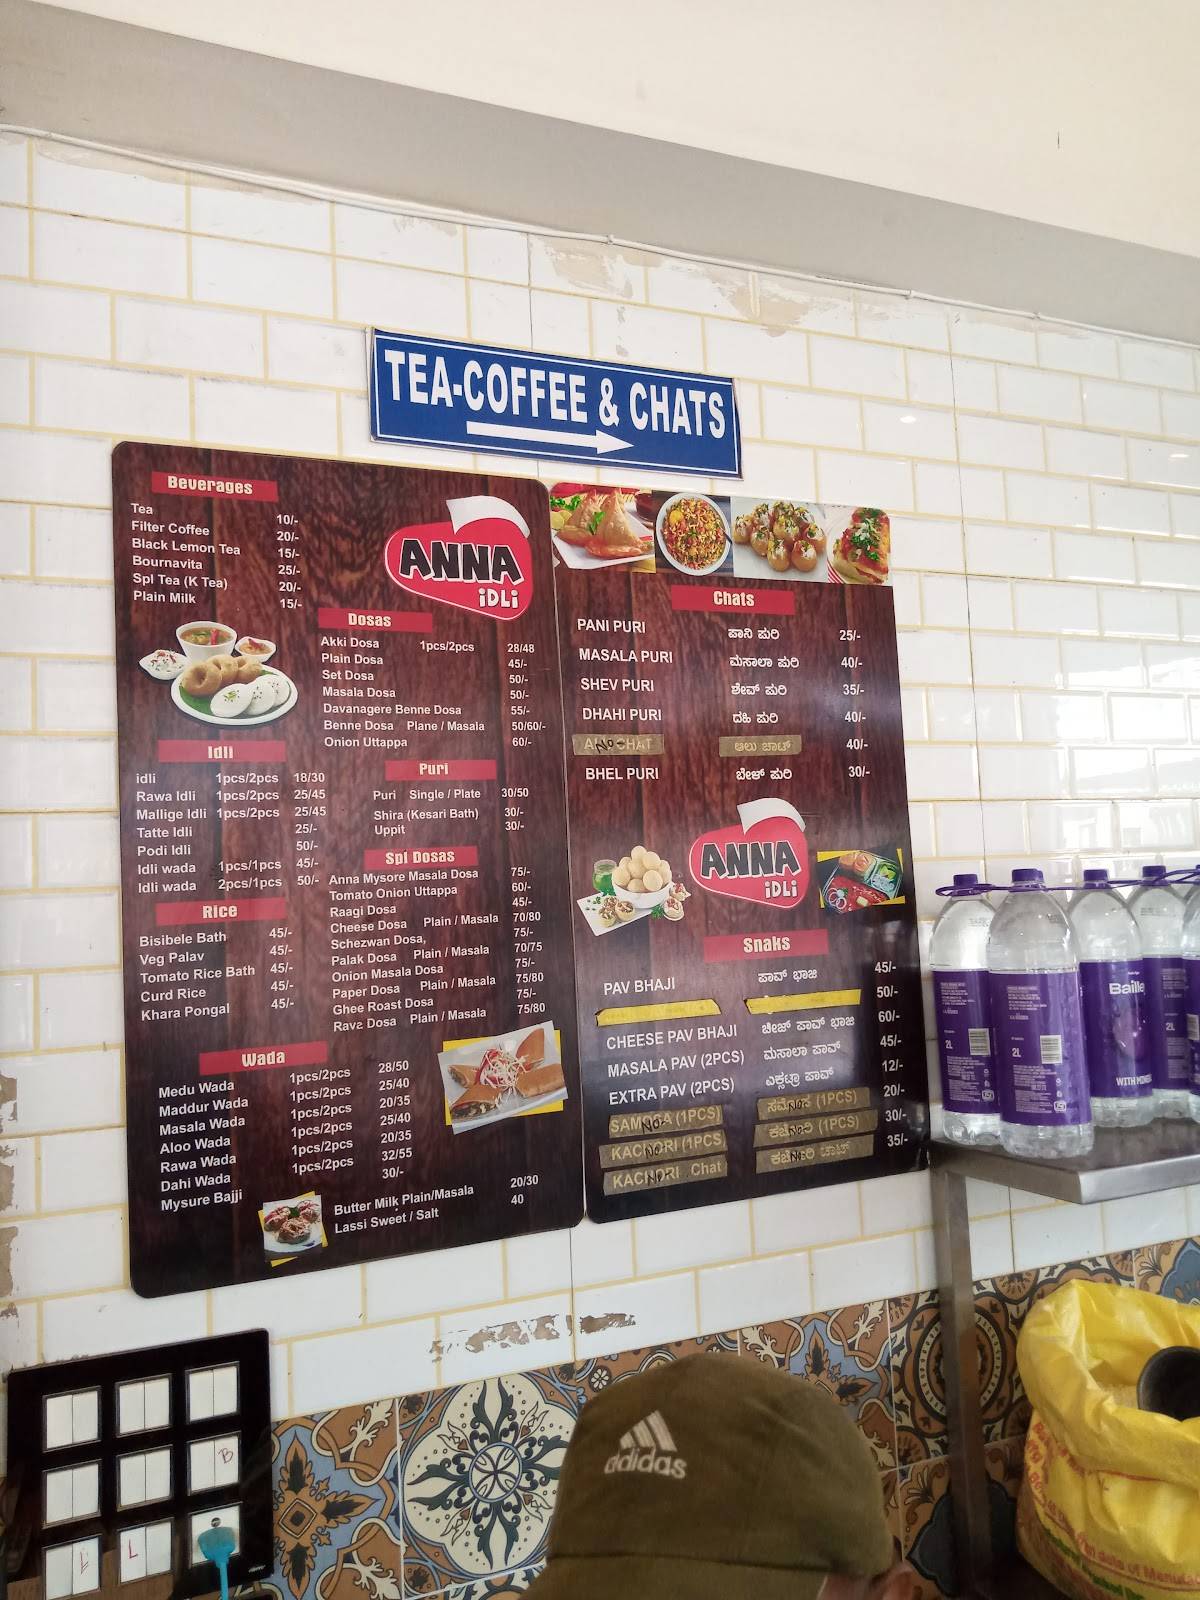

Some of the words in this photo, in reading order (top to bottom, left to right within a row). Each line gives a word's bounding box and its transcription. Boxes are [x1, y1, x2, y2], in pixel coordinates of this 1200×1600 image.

[384, 349, 588, 423] TEA-COFFEE
[599, 378, 620, 426] &
[629, 382, 726, 438] CHATS
[168, 476, 252, 494] Beverages
[131, 503, 152, 514] Tea
[277, 514, 298, 524] 10/-
[132, 521, 165, 532] Filter
[169, 523, 209, 535] Coffee
[277, 531, 299, 541] 20/-
[133, 538, 167, 549] Black
[172, 541, 215, 553] Lemon
[219, 544, 240, 554] Tea
[278, 548, 299, 558] 15/-
[133, 556, 202, 569] Bournavita
[279, 565, 300, 575] 25/-
[399, 538, 524, 586] ANNA
[133, 573, 153, 586] Spl
[158, 575, 180, 585] Tea
[184, 576, 198, 588] (K
[202, 577, 227, 590] Tea)
[279, 582, 301, 592] 20/-
[134, 590, 165, 601] Plain
[170, 593, 195, 603] Milk
[280, 599, 302, 608] 15/-
[714, 591, 754, 606] Chats
[349, 613, 391, 626] Dosas
[578, 619, 609, 631] PANI
[614, 620, 645, 633] PURI
[840, 630, 860, 640] 25/-
[321, 637, 346, 646] Akki
[351, 638, 379, 648] Dosa
[420, 641, 474, 653] 1pcs/2pcs
[508, 644, 534, 653] 28/48
[322, 653, 350, 663] Plain
[355, 654, 383, 664] Dosa
[508, 659, 527, 668] 45/-
[579, 648, 638, 662] MASALA
[641, 651, 672, 663] PURI
[841, 657, 862, 668] 40/-
[323, 687, 363, 696] Masala
[367, 688, 395, 697] Dosa
[511, 690, 529, 699] 50/-
[581, 678, 618, 690] SHEV
[622, 679, 654, 691] PURI
[843, 684, 864, 695] 35/-
[324, 704, 391, 716] Davanagere
[396, 705, 430, 714] Benne
[434, 705, 461, 714] Dosa
[511, 706, 529, 715] 55/-
[583, 708, 625, 720] DHAHI
[630, 709, 661, 720] PURI
[845, 711, 866, 722] 40/-
[325, 737, 359, 746] Onion
[364, 737, 407, 749] Uttappa
[513, 737, 531, 746] 60/-
[208, 746, 233, 759] Idli
[420, 763, 448, 775] Puri
[586, 768, 623, 779] BHEL
[627, 768, 658, 779] PURI
[849, 766, 870, 777] 30/-
[137, 774, 155, 783] idli
[216, 773, 278, 785] 1pcs/2pcs
[294, 773, 324, 782] 18/30
[137, 792, 172, 801] Rawa
[177, 791, 195, 801] Idli
[217, 790, 279, 803] 1pcs/2pcs
[295, 789, 325, 799] 25/45
[373, 790, 395, 800] Puri
[410, 790, 444, 801] Single
[454, 789, 480, 798] Plate
[502, 788, 528, 797] 30/50
[137, 809, 183, 821] Mallige
[188, 809, 206, 818] Idli
[217, 808, 279, 820] 1pcs/2pcs
[295, 807, 326, 816] 25/45
[374, 811, 403, 820] Shira
[407, 810, 446, 821] (Kesari
[450, 808, 478, 819] Bath)
[505, 807, 523, 816] 30/-
[375, 825, 405, 836] Uppit
[506, 821, 524, 830] 30/-
[413, 851, 454, 863] Dosas
[699, 840, 802, 880] ANNA
[329, 875, 359, 885] Anna
[364, 874, 405, 885] Mysore
[409, 870, 447, 880] Masala
[451, 870, 478, 879] Dosa
[511, 867, 530, 876] 75/-
[329, 890, 372, 900] Tomato
[376, 888, 410, 898] Onion
[415, 887, 457, 897] Uttappa
[512, 882, 531, 891] 60/-
[203, 905, 237, 918] Rice
[140, 934, 192, 946] Bisibele
[197, 932, 226, 943] Bath
[269, 928, 292, 938] 45/-
[331, 938, 390, 949] Schezwan
[514, 927, 533, 937] 75/-
[744, 936, 790, 952] Snaks
[140, 971, 189, 983] Tomato
[194, 969, 222, 979] Rice
[226, 965, 255, 977] Bath
[271, 962, 293, 973] 45/-
[604, 981, 630, 995] PAV
[635, 977, 675, 992] BHAJI
[142, 1010, 180, 1021] Khara
[185, 1003, 229, 1017] Pongal
[271, 998, 294, 1008] 45/-
[333, 1005, 364, 1015] Ghee
[368, 1000, 401, 1011] Roast
[405, 999, 433, 1008] Dosa
[517, 988, 536, 998] 75/-
[1166, 1022, 1175, 1031] 2L
[607, 1032, 663, 1049] CHEESE
[668, 1029, 693, 1043] PAV
[698, 1025, 736, 1040] BHAJI
[242, 1051, 285, 1067] Wada
[1012, 1047, 1021, 1058] 2L
[159, 1085, 194, 1098] Medu
[199, 1081, 234, 1093] Wada
[290, 1069, 350, 1085] 1pcs/2pcs
[379, 1061, 408, 1073] 28/50
[160, 1103, 209, 1117] Maddur
[213, 1097, 248, 1110] Wada
[290, 1087, 351, 1103] 1pcs/2pcs
[379, 1078, 409, 1090] 25/40
[610, 1087, 657, 1105] EXTRA
[661, 1083, 686, 1098] PAV
[691, 1078, 734, 1097] (2PCS)
[162, 1197, 210, 1212] Mysure
[214, 1189, 242, 1203] Bajji
[383, 1167, 403, 1178] 30/-
[335, 1202, 371, 1215] Butter
[375, 1197, 399, 1210] Milk
[402, 1185, 473, 1204] Plain/Masala
[511, 1175, 538, 1188] 20/30
[604, 1447, 687, 1480] adidas
